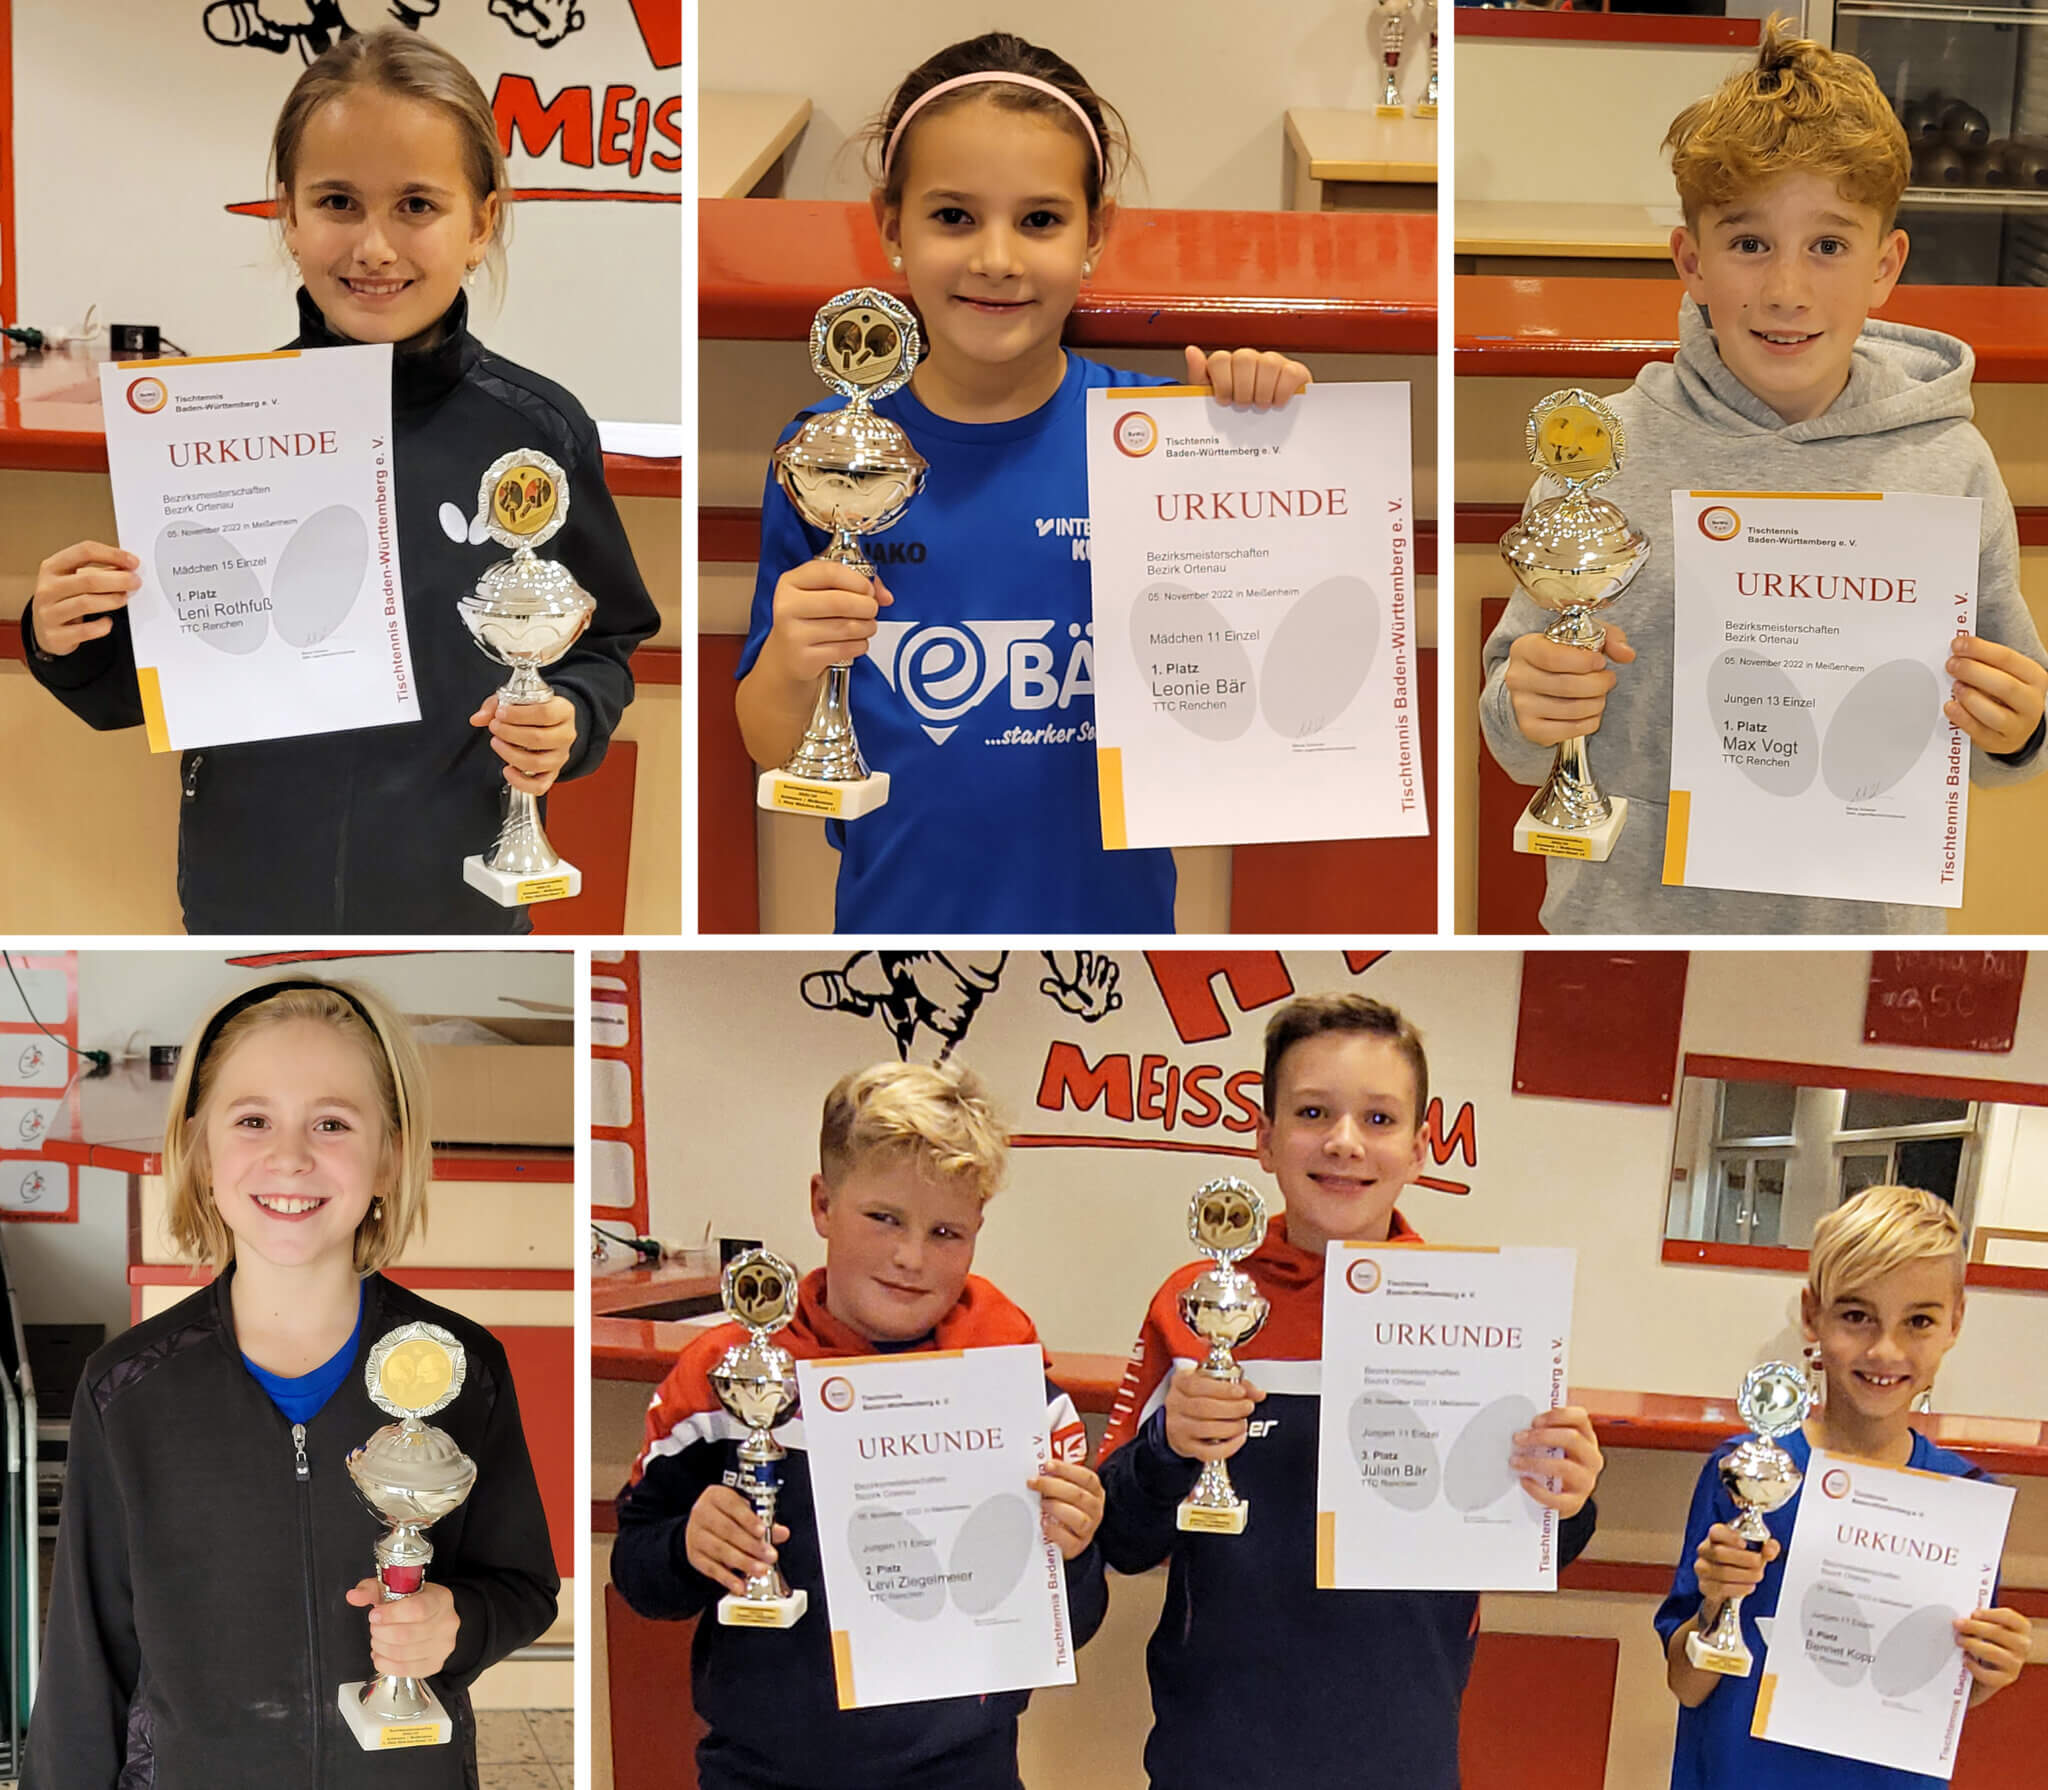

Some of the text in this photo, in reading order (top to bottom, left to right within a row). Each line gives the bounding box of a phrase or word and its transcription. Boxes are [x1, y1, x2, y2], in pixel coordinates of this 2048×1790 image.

[175, 393, 223, 403] Tischtennis
[168, 430, 338, 467] URKUNDE
[1165, 436, 1219, 446] Tischtennis
[1166, 447, 1259, 458] Baden-Württemberg
[162, 485, 270, 503] Bezirksmeisterschaften
[164, 501, 234, 515] Bezirk Ortenau
[1155, 488, 1348, 521] URKUNDE
[1747, 526, 1799, 535] Tischtennis
[1747, 536, 1836, 547] Baden-Württemberg
[1848, 539, 1857, 547] V.
[1146, 547, 1269, 562] Bezirksmeisterschaften
[172, 556, 267, 576] Mädchen 15 Einzel
[371, 435, 408, 703] Tischtennis Baden-Württemberg e. V.
[1147, 563, 1226, 575] Bezirk Ortenau
[1164, 591, 1209, 601] November
[1211, 589, 1233, 599] 2022
[1235, 589, 1243, 598] in
[1736, 572, 1917, 603] URKUNDE
[175, 589, 217, 602] 1. Platz
[1954, 592, 1968, 605] V.
[177, 597, 273, 621] Leni Rothfuß
[1956, 611, 1968, 624] e.
[180, 619, 243, 634] TTC Renchen
[1725, 620, 1839, 635] Bezirksmeisterschaften
[1150, 630, 1260, 645] Mädchen 11 Einzel
[1725, 632, 1799, 645] Bezirk Ortenau
[1387, 497, 1415, 812] Tischtennis Baden-Württemberg e. V.
[1151, 663, 1199, 675] 1. Platz
[1739, 657, 1781, 667] November
[1783, 660, 1804, 669] 2022
[1806, 661, 1813, 669] in
[1152, 678, 1246, 697] Leonie Bär
[1152, 699, 1226, 712] TTC Renchen
[1723, 693, 1815, 708] Jungen 13 Einzel
[1723, 720, 1767, 733] 1. Platz
[1723, 736, 1798, 757] Max Vogt
[1722, 754, 1790, 767] TTC Renchen
[1941, 792, 1958, 884] Tischtennis
[1375, 1323, 1522, 1348] URKUNDE
[858, 1427, 1004, 1459] URKUNDE
[1373, 1451, 1398, 1460] Platz
[1361, 1464, 1427, 1477] Julian Bär
[1836, 1524, 1960, 1566] URKUNDE
[867, 1570, 973, 1592] Levi Ziegelmeier
[1051, 1593, 1066, 1666] Tischtennis
[1846, 1648, 1876, 1665] Kopp
